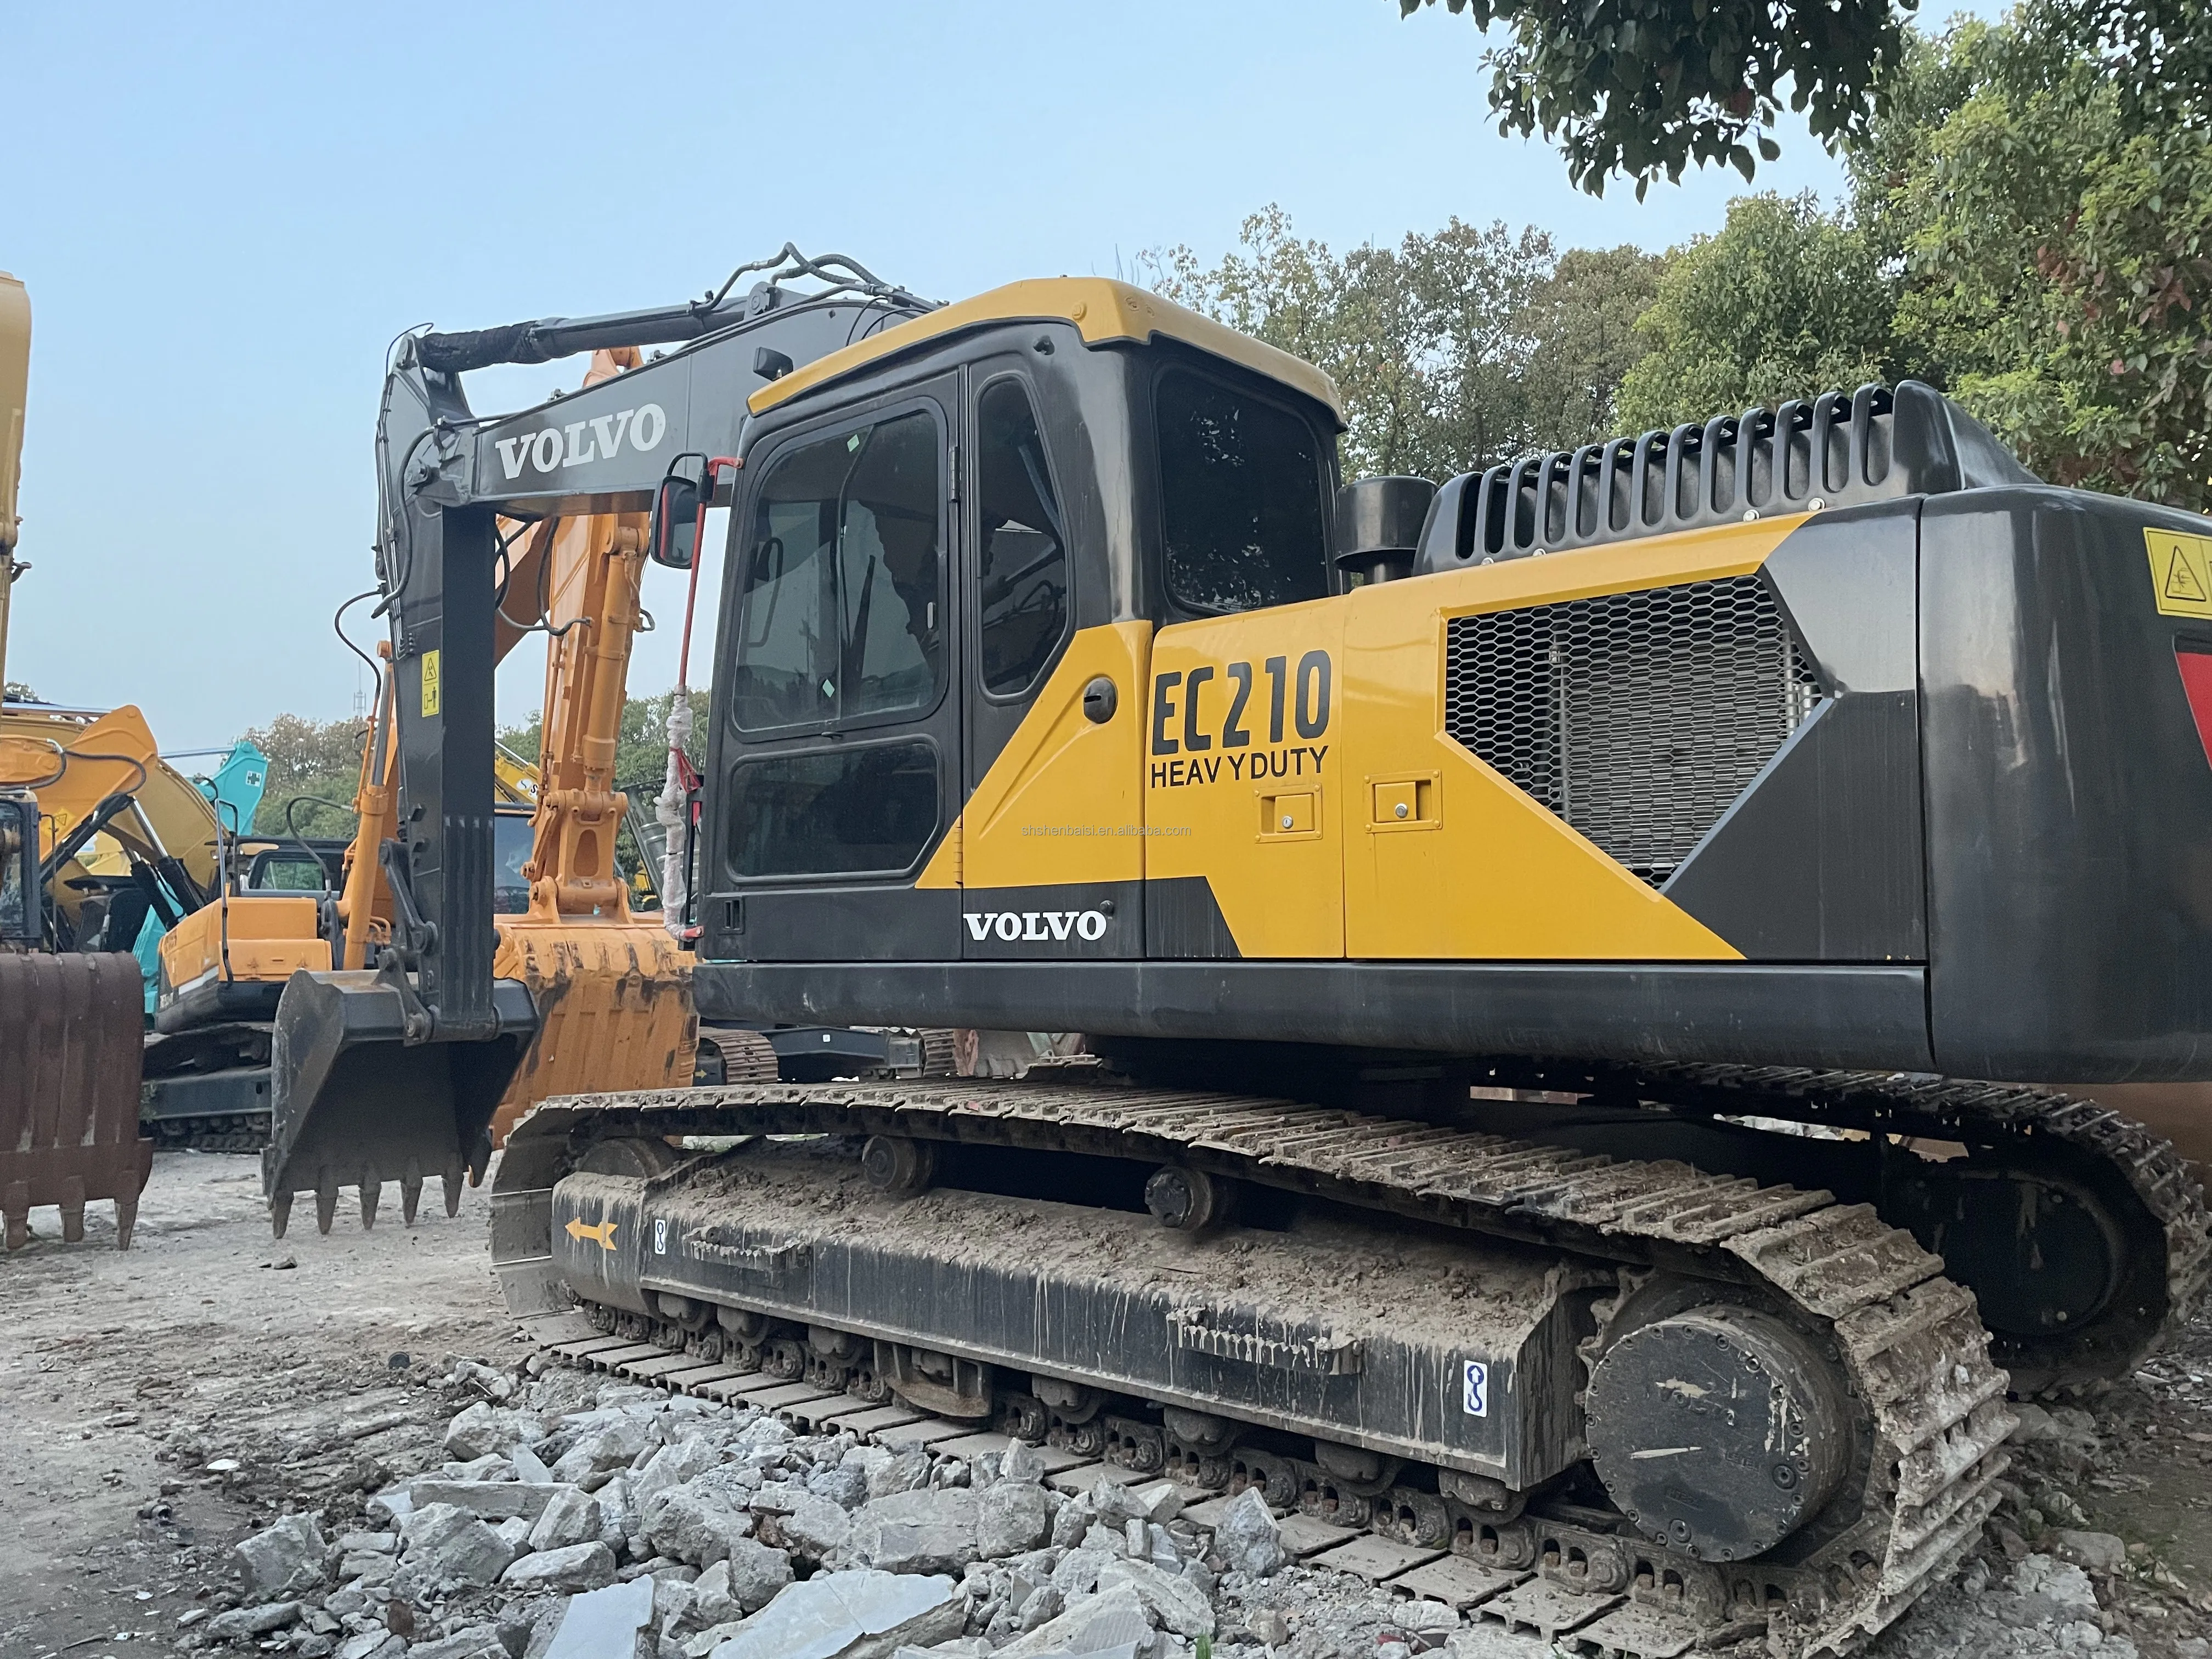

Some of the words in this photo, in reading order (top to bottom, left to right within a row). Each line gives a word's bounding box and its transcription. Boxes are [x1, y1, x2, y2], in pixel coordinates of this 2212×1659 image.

[495, 403, 666, 480] VOLVO
[1152, 650, 1331, 756] EC210
[963, 910, 1108, 941] VOLVO
